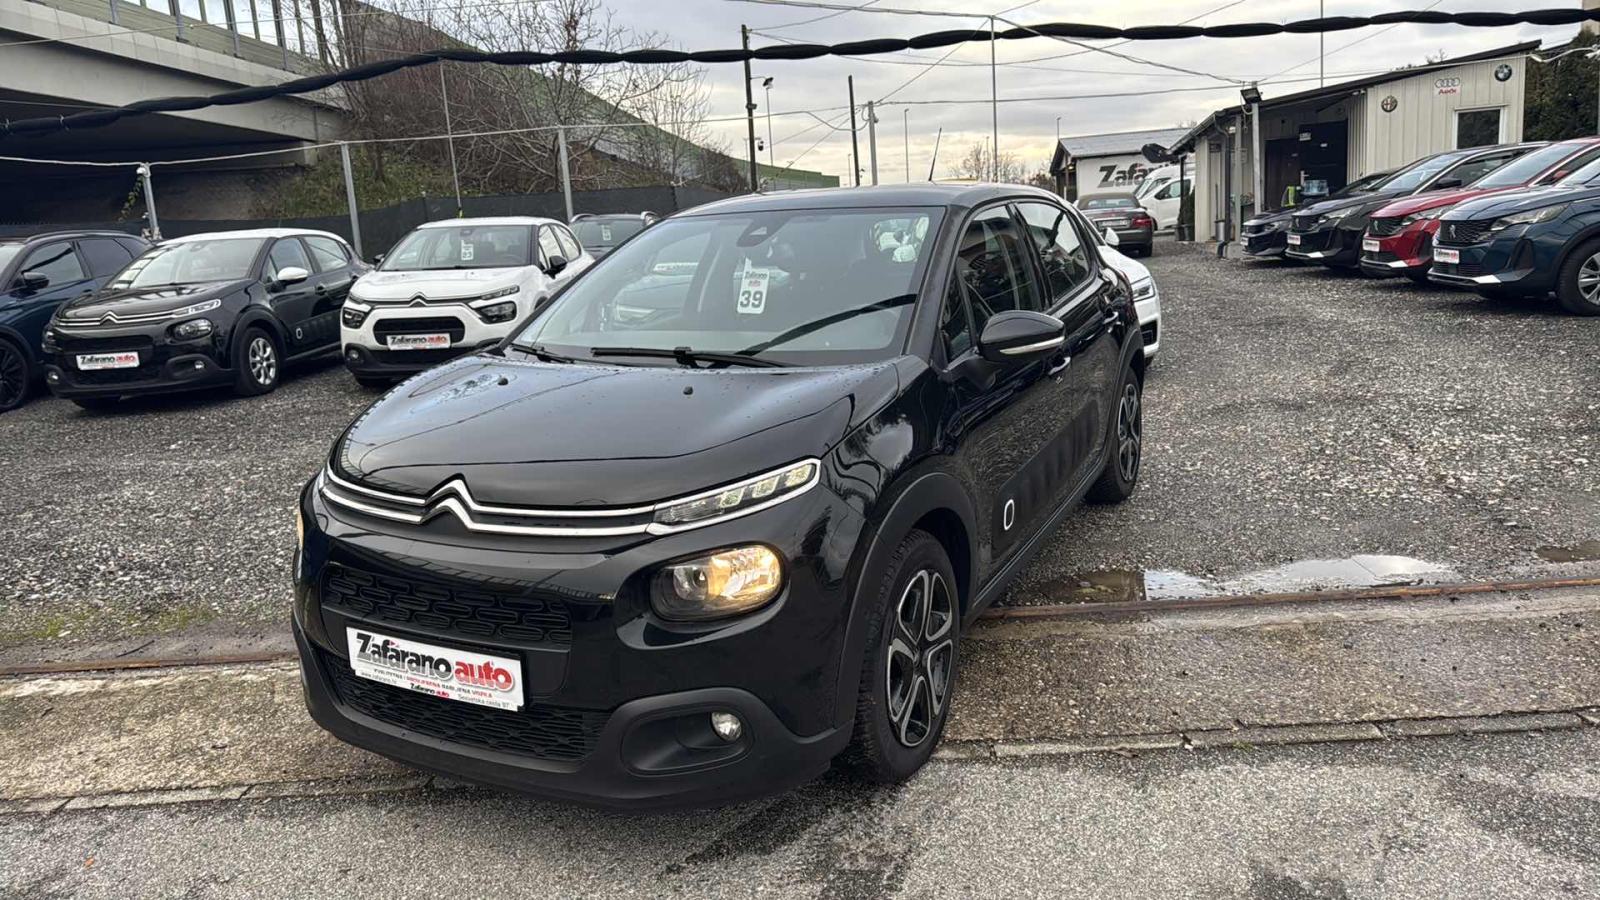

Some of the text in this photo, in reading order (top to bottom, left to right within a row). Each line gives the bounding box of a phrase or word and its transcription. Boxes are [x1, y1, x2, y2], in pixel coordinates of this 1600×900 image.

[739, 290, 763, 308] 39
[356, 632, 514, 691] Zafarano auto
